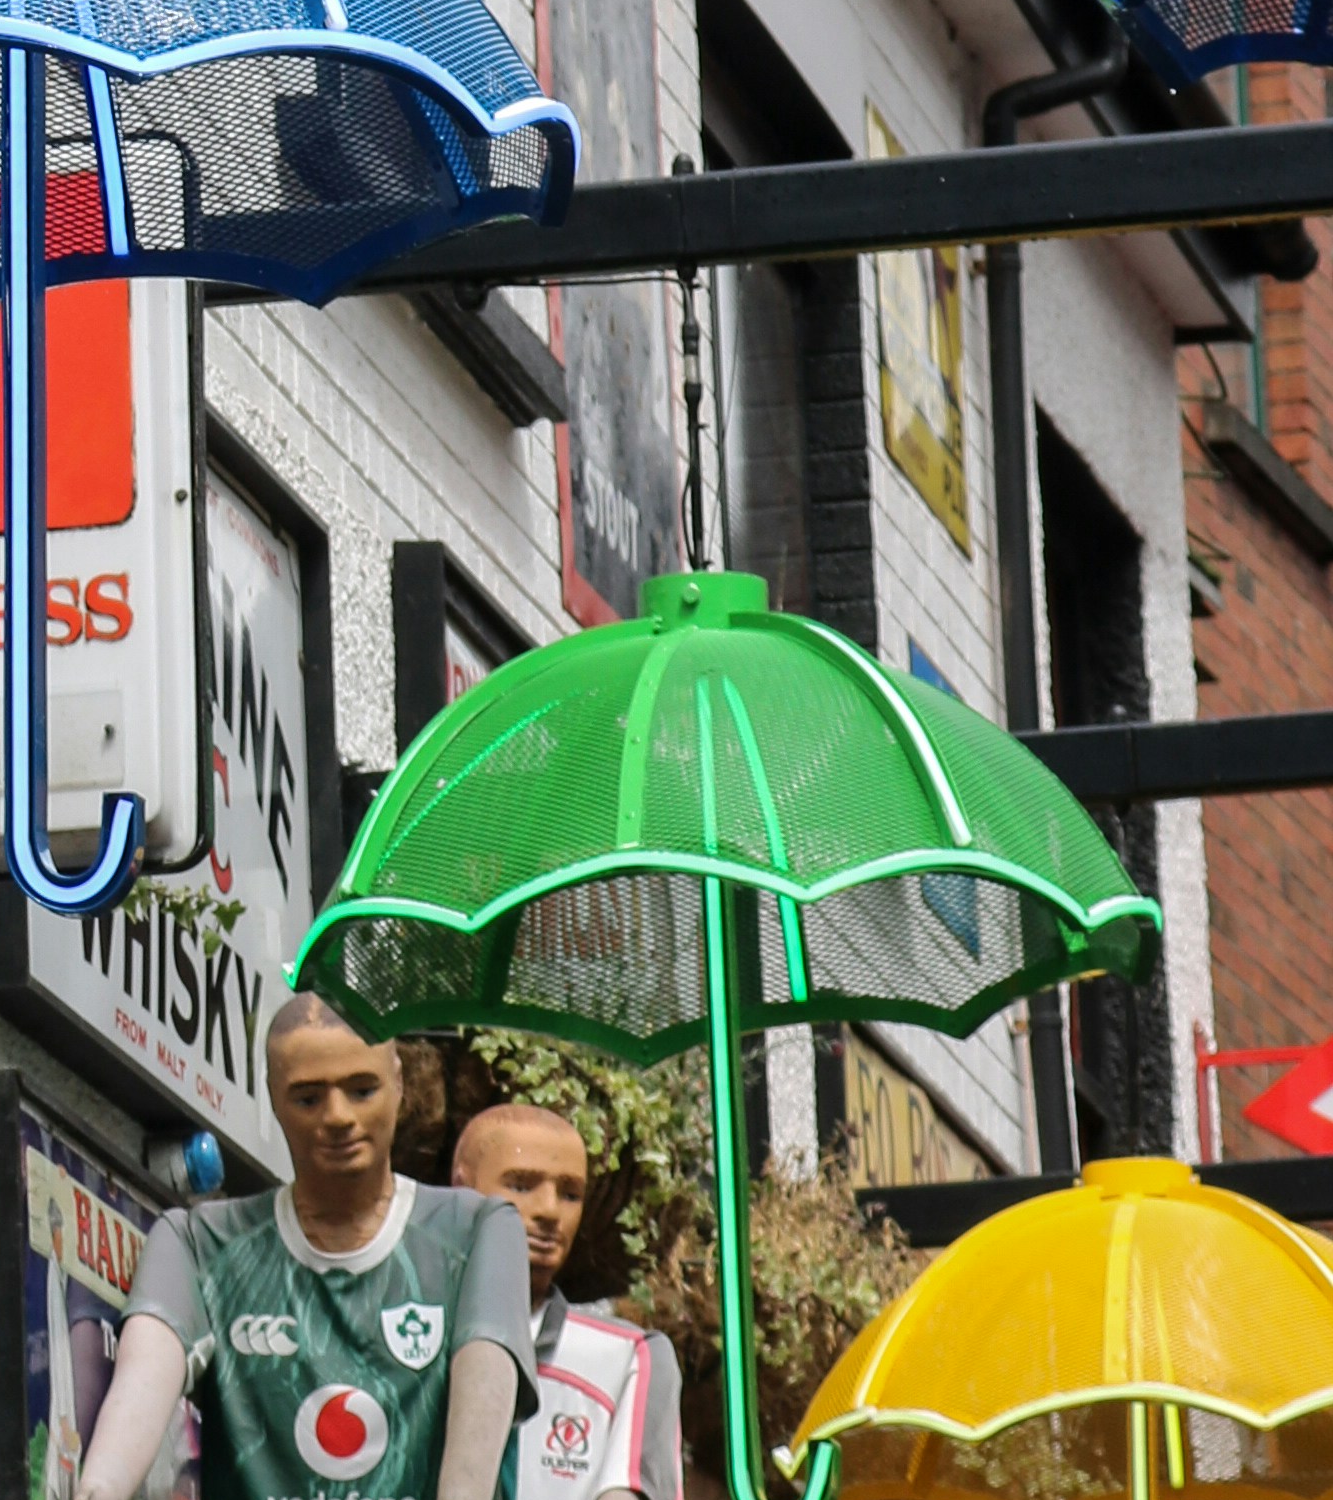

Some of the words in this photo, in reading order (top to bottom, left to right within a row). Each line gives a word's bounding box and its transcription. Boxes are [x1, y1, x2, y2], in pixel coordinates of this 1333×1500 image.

[584, 456, 639, 573] STOUT
[114, 1007, 148, 1052] FROM
[156, 1035, 187, 1079] MALT
